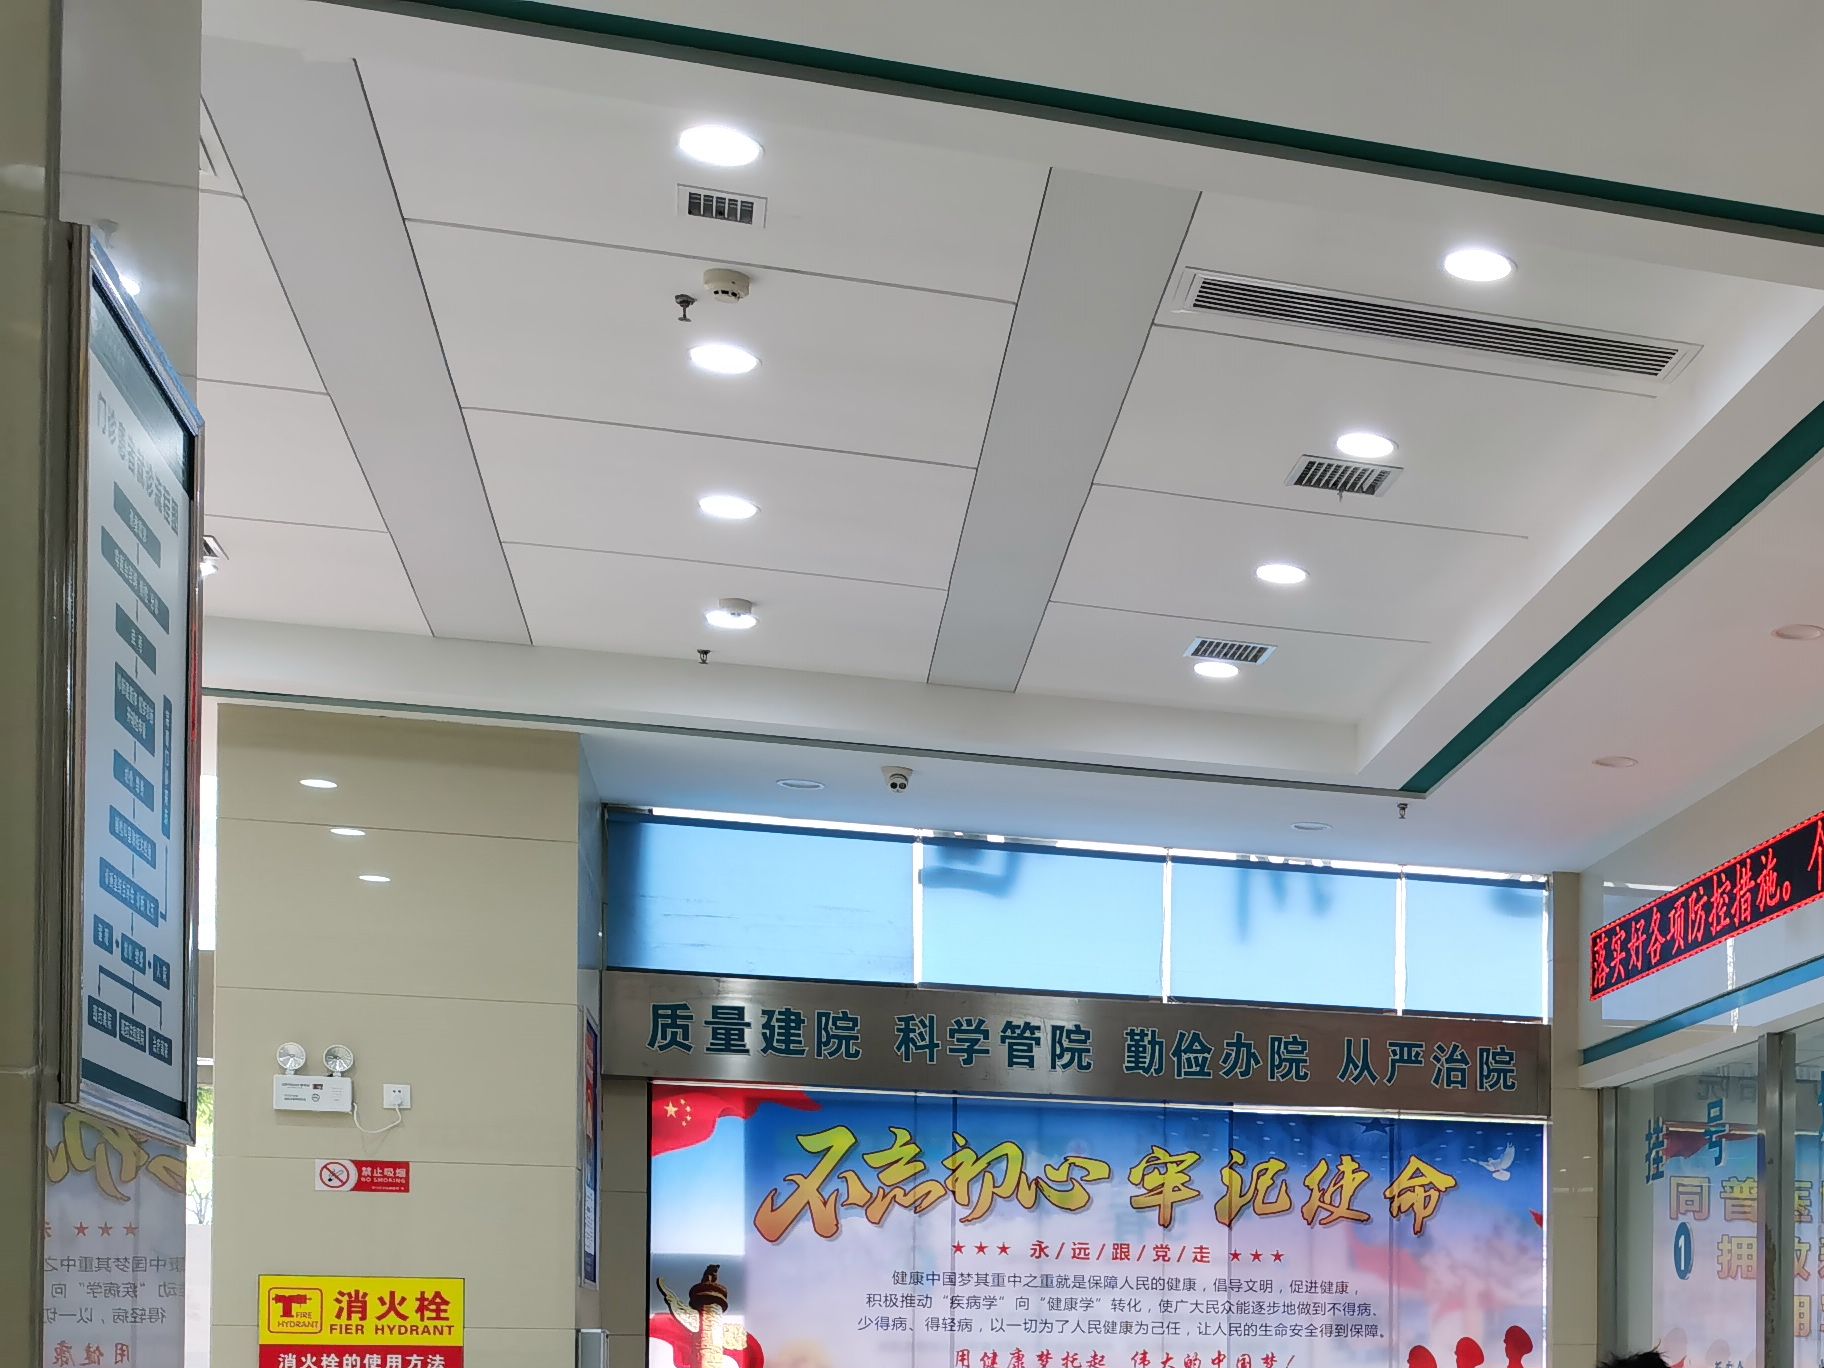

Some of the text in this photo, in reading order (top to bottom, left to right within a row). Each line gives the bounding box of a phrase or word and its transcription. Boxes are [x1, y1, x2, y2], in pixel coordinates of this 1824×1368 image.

[646, 1002, 1519, 1093] 质量建院 科学管院 勤俭办院 从严治院
[1644, 1098, 1729, 1184] 挂号
[361, 1166, 407, 1178] 禁止吸烟
[753, 1124, 1459, 1243] 不忘初心 牢记使命
[333, 1289, 452, 1322] 消火栓
[277, 1320, 320, 1329] HYDRANT
[329, 1323, 455, 1336] FIER HYDRANT
